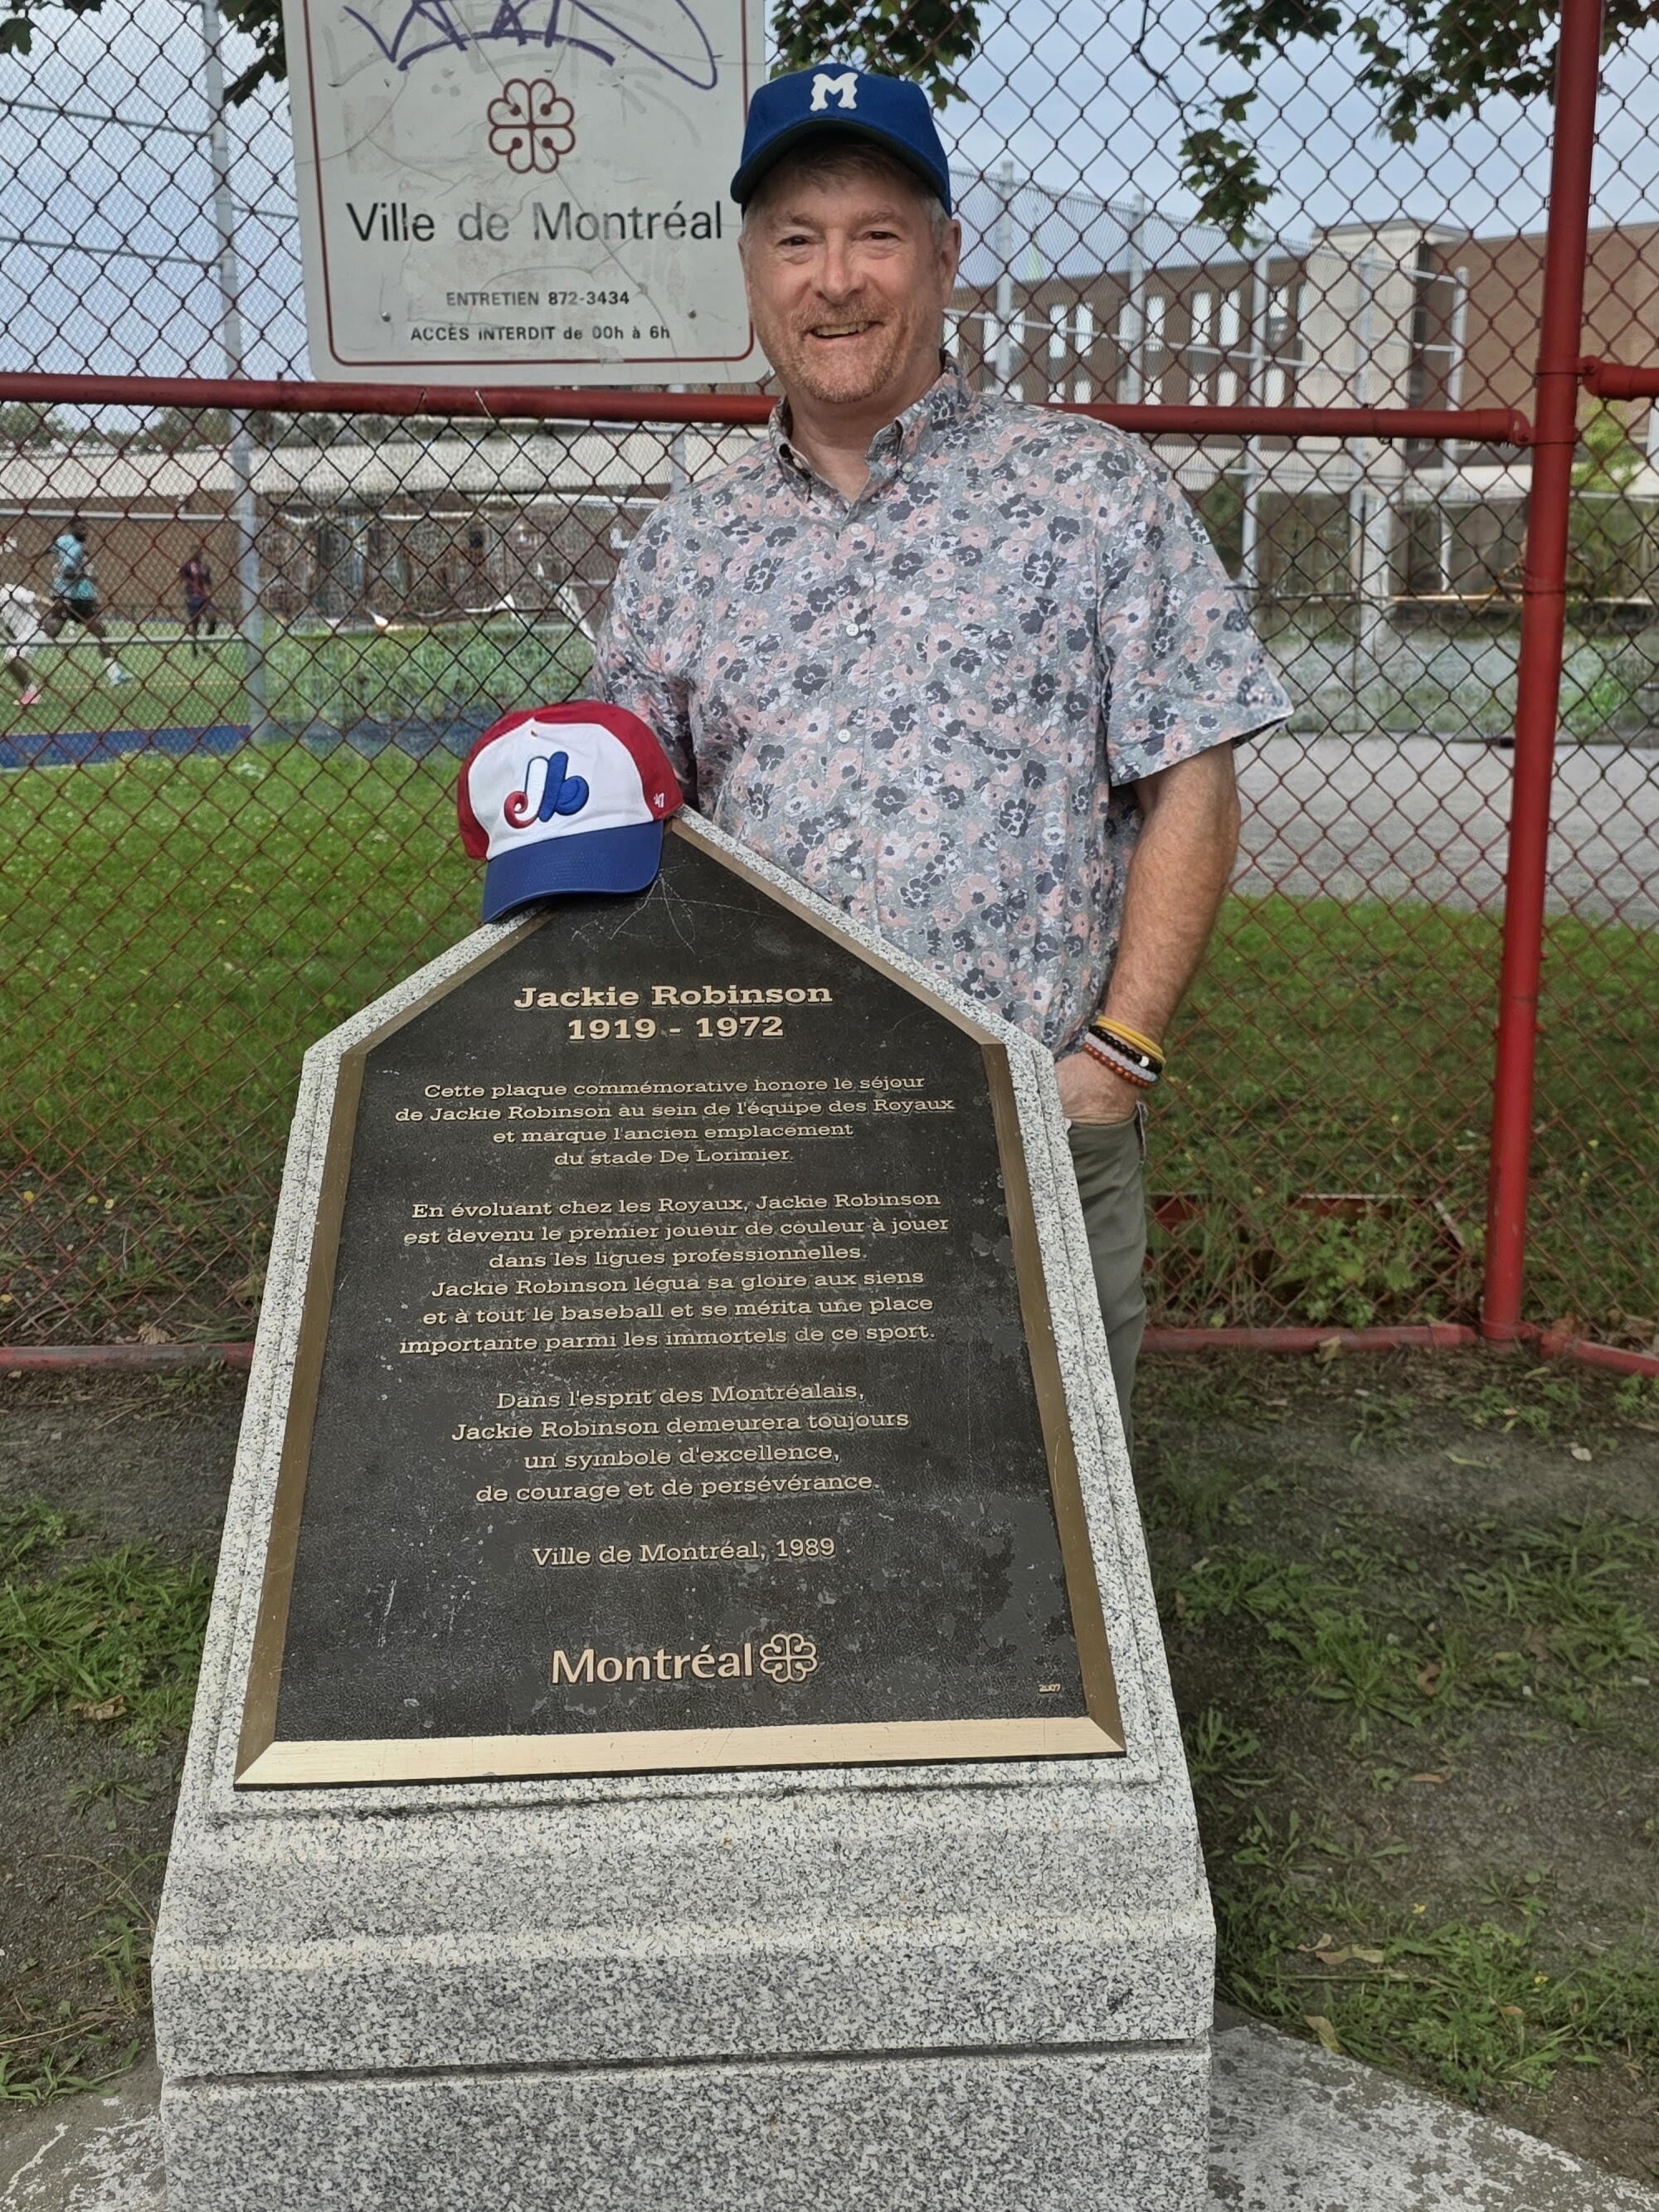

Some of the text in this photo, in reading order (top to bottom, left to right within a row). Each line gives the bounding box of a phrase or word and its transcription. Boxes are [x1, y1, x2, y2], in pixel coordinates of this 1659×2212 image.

[810, 72, 859, 111] M
[346, 200, 722, 242] Ville de Montréal
[446, 290, 630, 307] ENTRETIEN 872-3434
[411, 324, 670, 341] ACCÈS INTERDIT de 00h à 6h
[513, 984, 833, 1009] Jackie Robinson
[567, 1018, 656, 1040] 1919
[696, 1016, 784, 1038] 1972
[424, 1076, 925, 1099] Cette plaque commémorative honore le séjour
[395, 1099, 956, 1122] de Jackie Robinson au sein de l'équipe des Royaux
[493, 1124, 854, 1144] et marque l'ancien emplacement
[554, 1152, 584, 1164] du
[591, 1150, 652, 1164] stade
[659, 1150, 689, 1162] De
[411, 1193, 941, 1218] En évoluant chez les Royaux, Jackie Robinson
[404, 1217, 949, 1244] est devenu le premier joueur de couleur à jouer
[489, 1245, 868, 1268] dans les ligues professionnelles.
[431, 1271, 924, 1297] Jackie Robinson légua sa gloire aux siens
[423, 1297, 933, 1325] et à tout le baseball et se mérita une place
[400, 1325, 935, 1355] importante parmi les immortels de ce sport.
[496, 1383, 864, 1409] Dans l'esprit des Montréalais,
[451, 1413, 909, 1441] Jackie Robinson demeurera toujours
[524, 1445, 839, 1471] un symbole d'excellence,
[476, 1474, 880, 1502] de courage et de persévérance.
[533, 1538, 834, 1565] Ville de Montréal, 1989
[552, 1642, 752, 1684] Montréal
